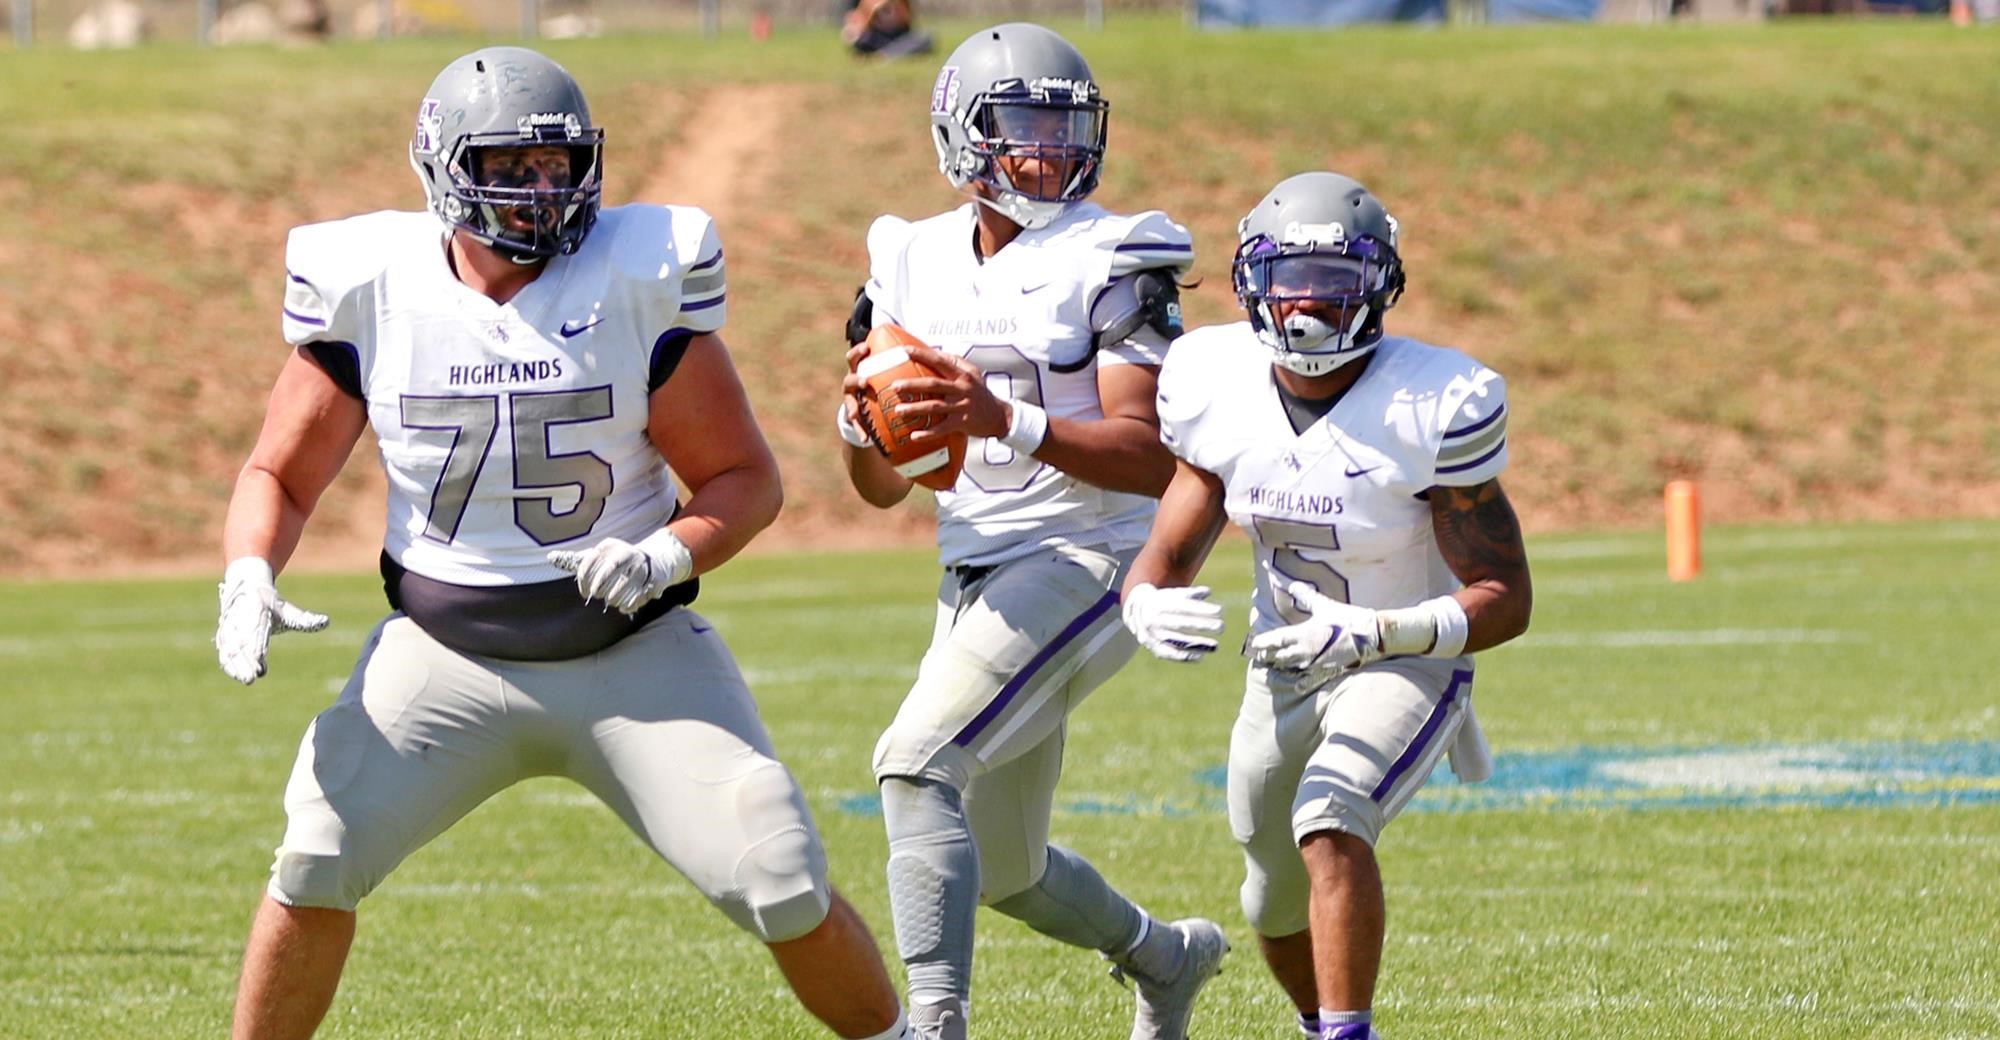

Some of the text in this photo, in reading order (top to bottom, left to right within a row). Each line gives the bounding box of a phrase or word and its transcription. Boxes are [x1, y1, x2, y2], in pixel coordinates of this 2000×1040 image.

[530, 113, 563, 126] Riddell
[928, 316, 1018, 337] HIGHLANDS
[449, 358, 563, 385] HIGHLANDS
[399, 384, 614, 547] 75
[1250, 487, 1344, 515] HIGHLANDS
[1252, 515, 1350, 626] 5
